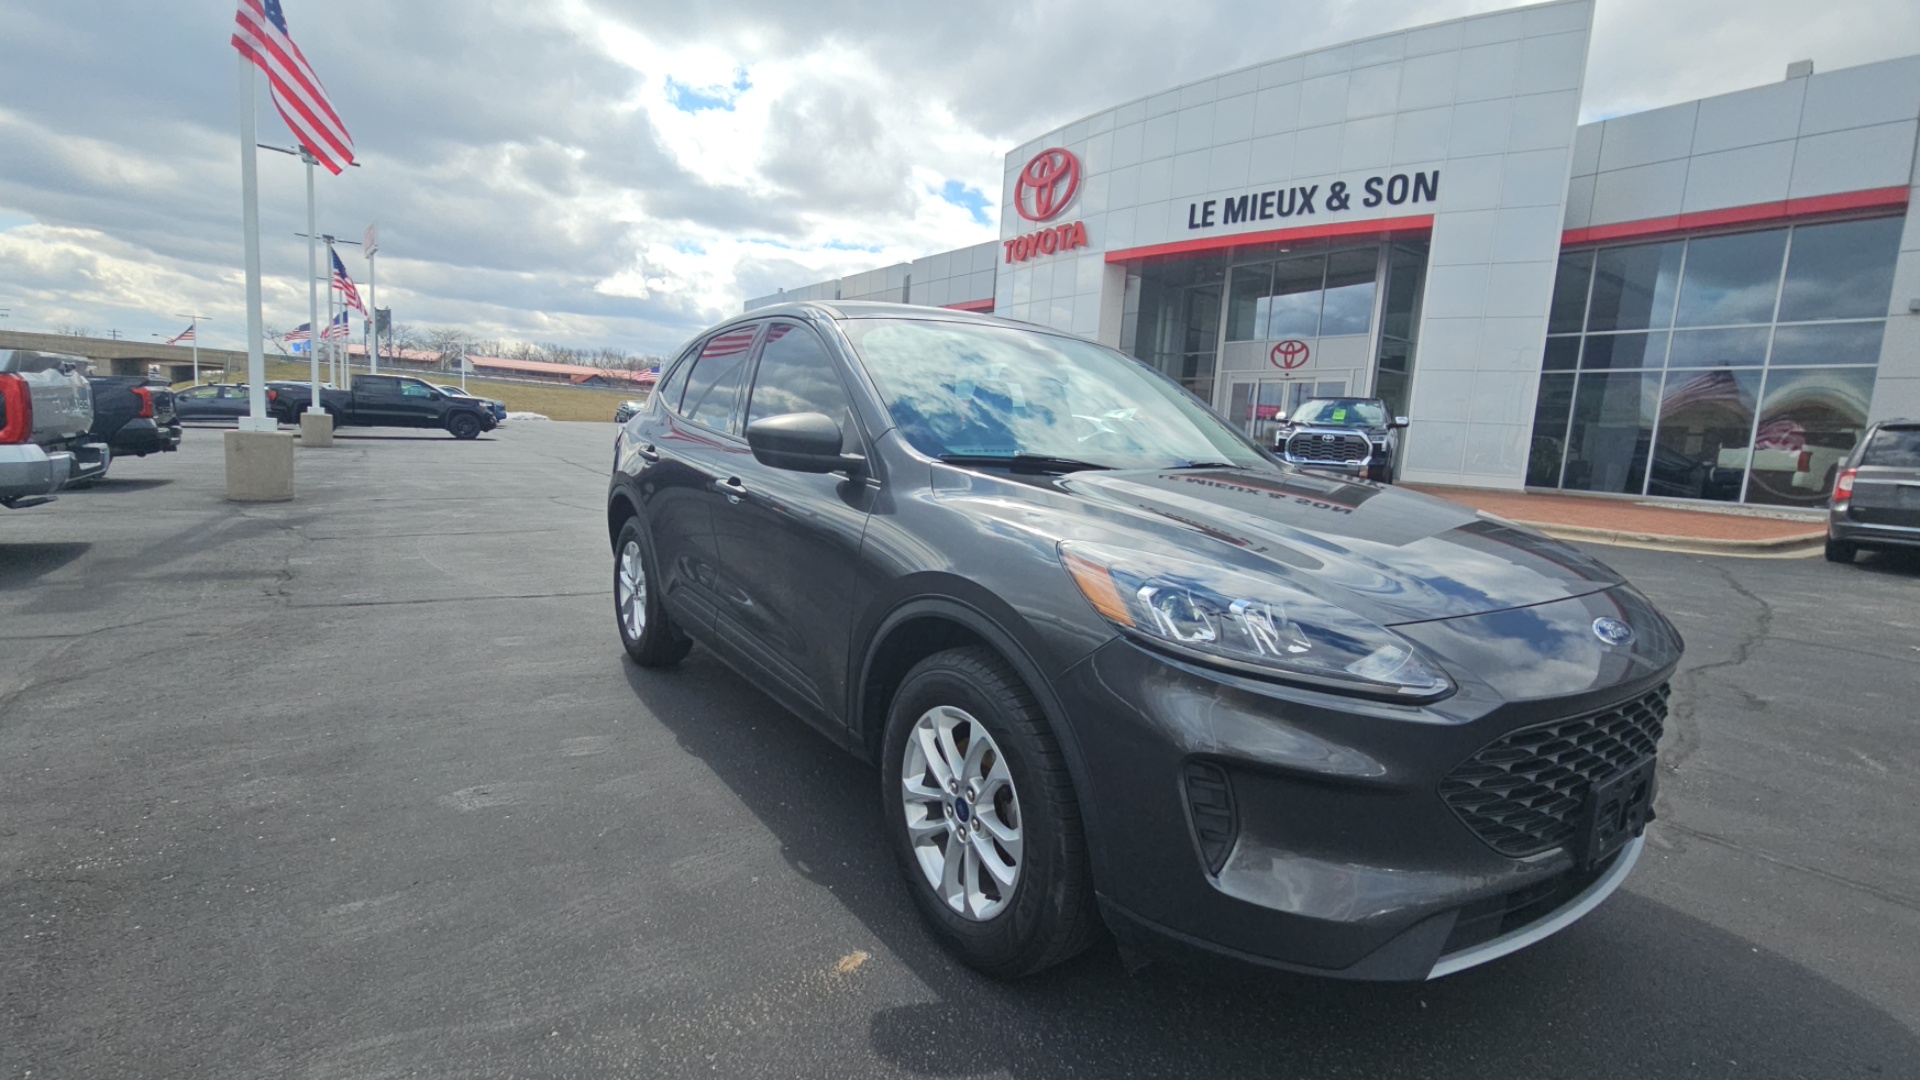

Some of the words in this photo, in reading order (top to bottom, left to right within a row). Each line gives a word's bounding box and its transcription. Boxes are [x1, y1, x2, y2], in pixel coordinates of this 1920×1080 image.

[1188, 200, 1217, 230] LE
[1223, 184, 1319, 225] MIEUX
[1325, 181, 1350, 212] &
[1363, 170, 1440, 208] SON
[1003, 221, 1088, 264] TOYOTA
